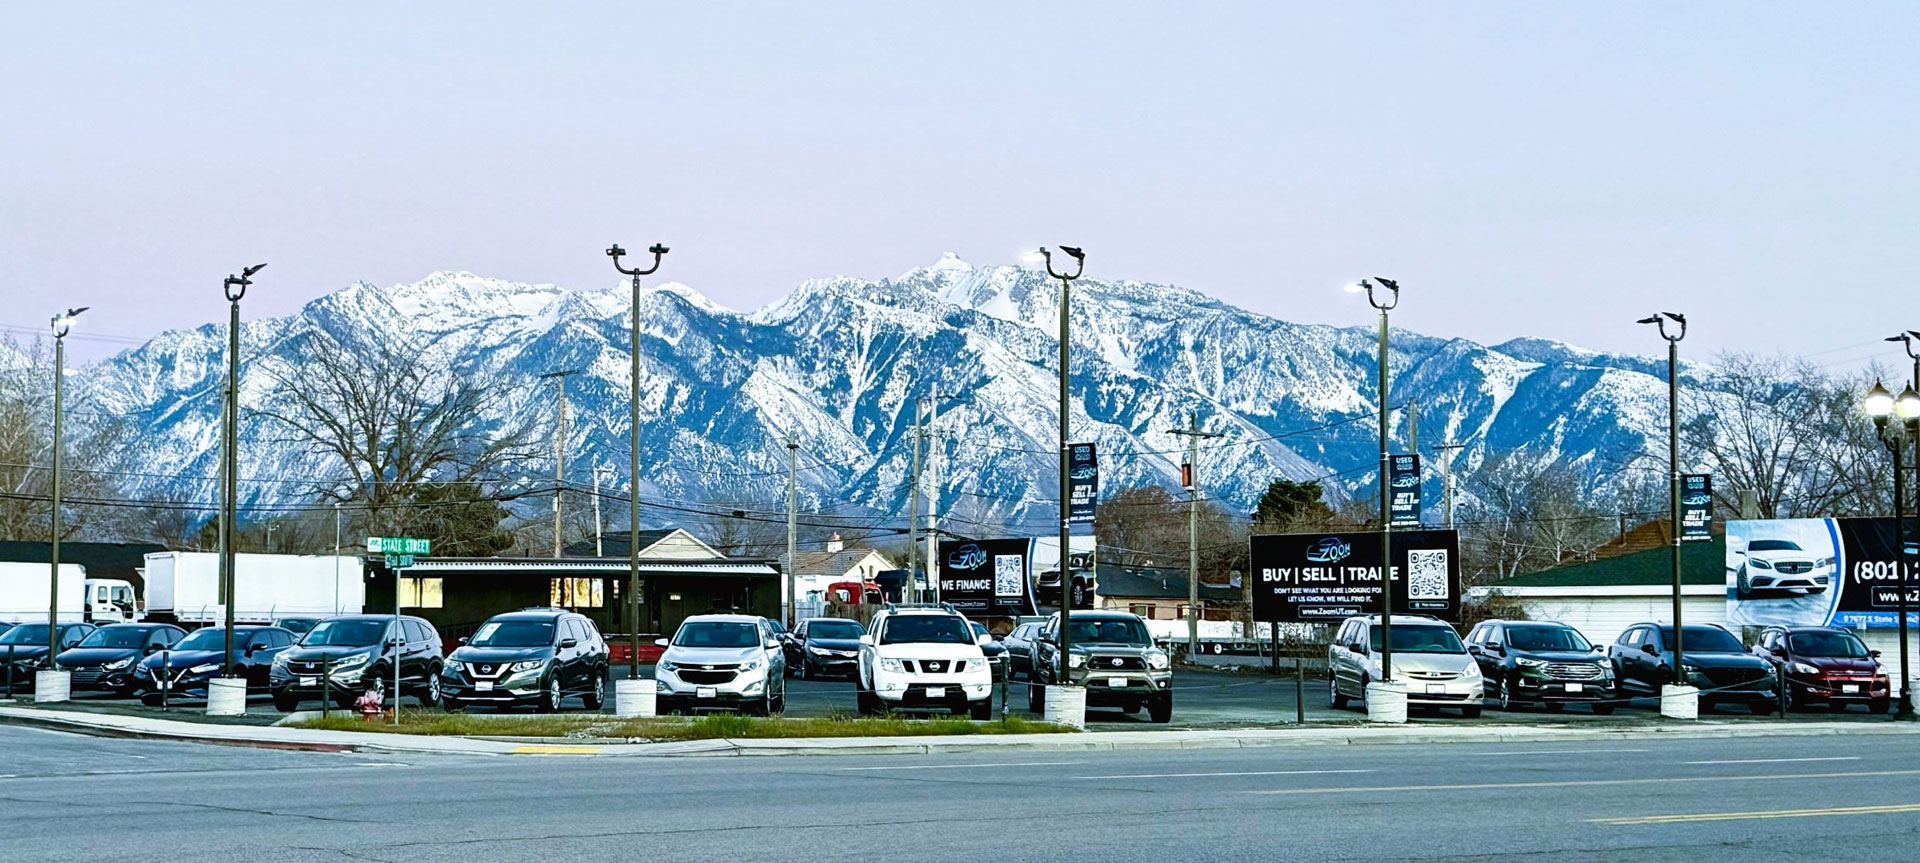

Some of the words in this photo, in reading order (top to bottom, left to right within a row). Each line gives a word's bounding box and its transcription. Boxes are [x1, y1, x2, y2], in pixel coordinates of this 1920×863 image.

[382, 538, 402, 551] STATE
[405, 539, 429, 553] STREET
[1319, 543, 1351, 560] ZOOM
[959, 549, 987, 569] ZOOM
[1262, 567, 1291, 582] BUY
[1302, 567, 1337, 581] SELL
[1347, 566, 1399, 581] TRAE
[1853, 561, 1908, 584] (801)
[941, 580, 954, 590] WE
[956, 579, 991, 590] FINANCE
